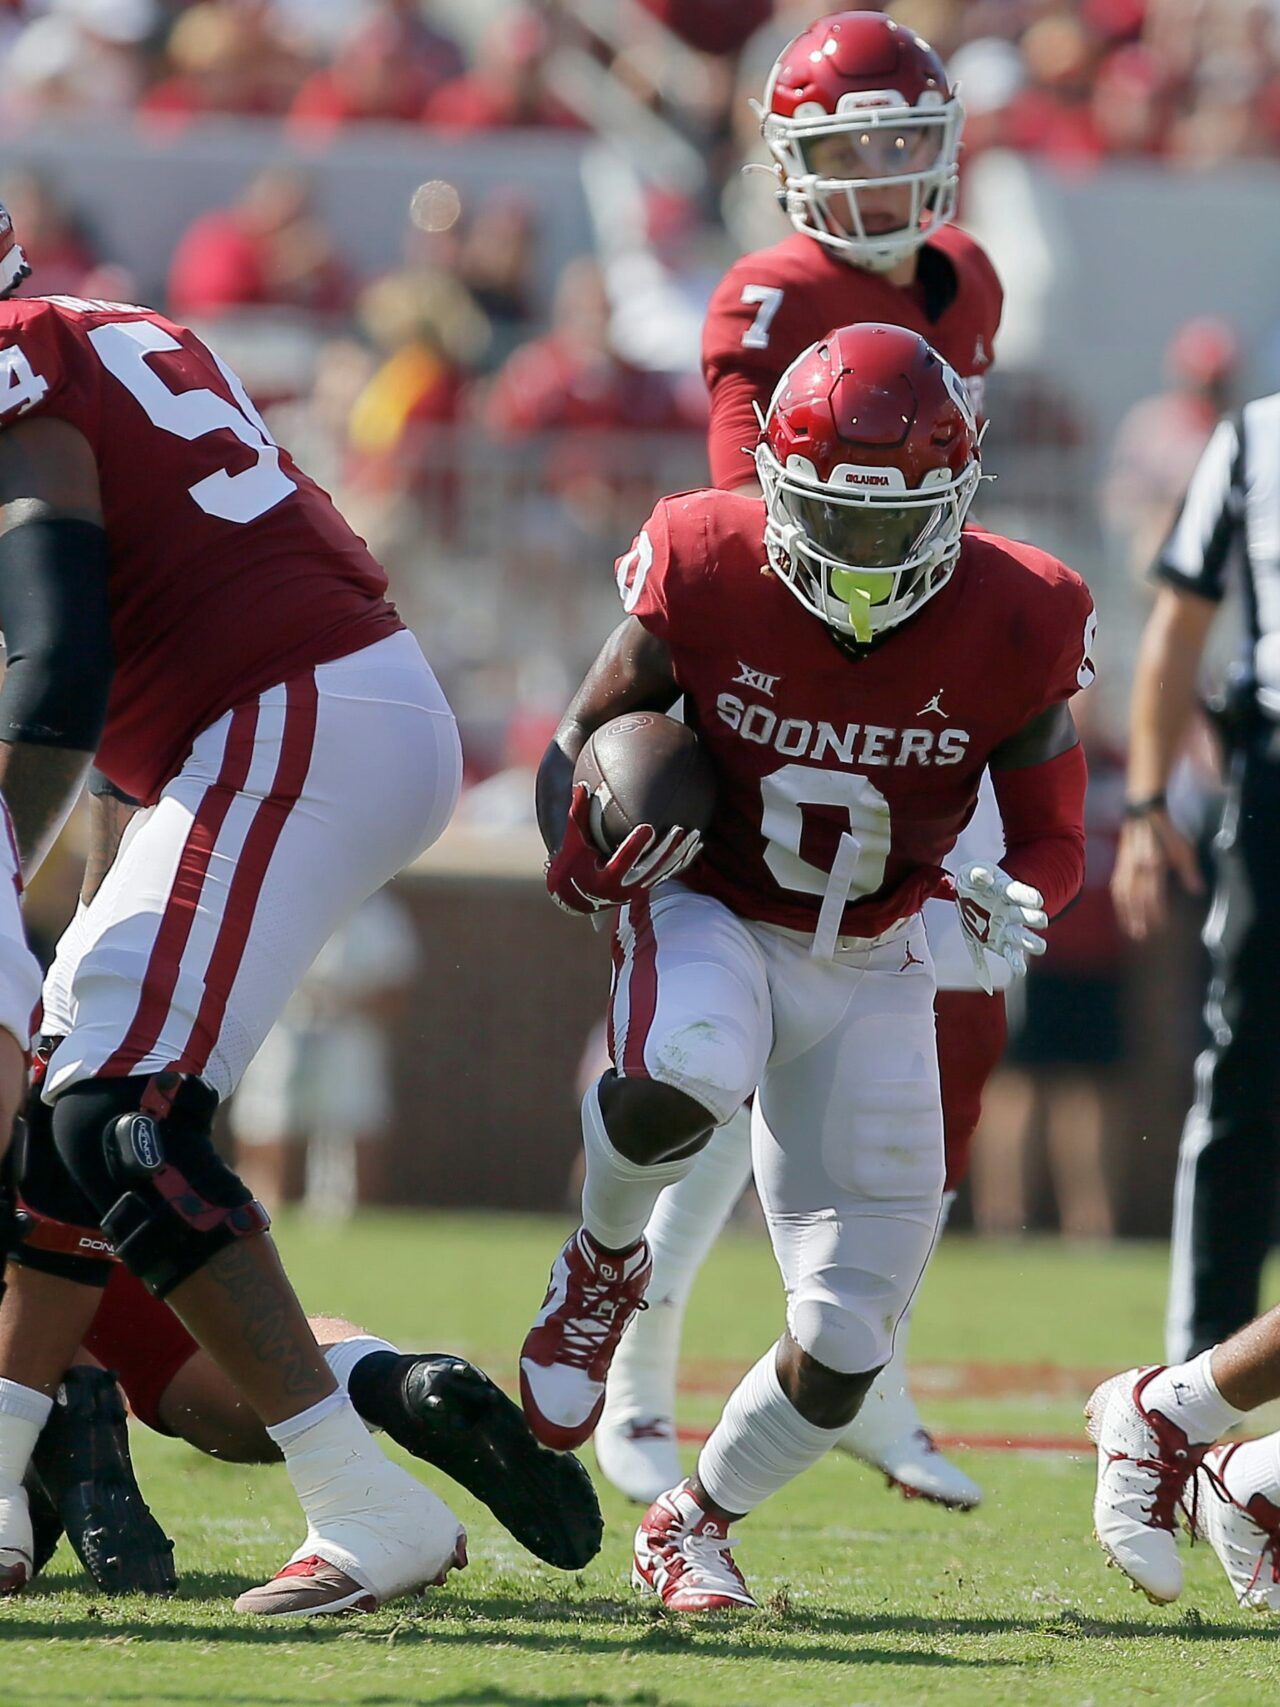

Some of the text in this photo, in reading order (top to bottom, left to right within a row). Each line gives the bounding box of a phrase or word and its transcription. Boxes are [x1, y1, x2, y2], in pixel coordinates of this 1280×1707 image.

[741, 284, 784, 350] 7
[846, 473, 889, 486] OKLAHOMA
[732, 660, 780, 697] XII
[716, 692, 970, 766] SOONERS
[760, 763, 891, 901] 0
